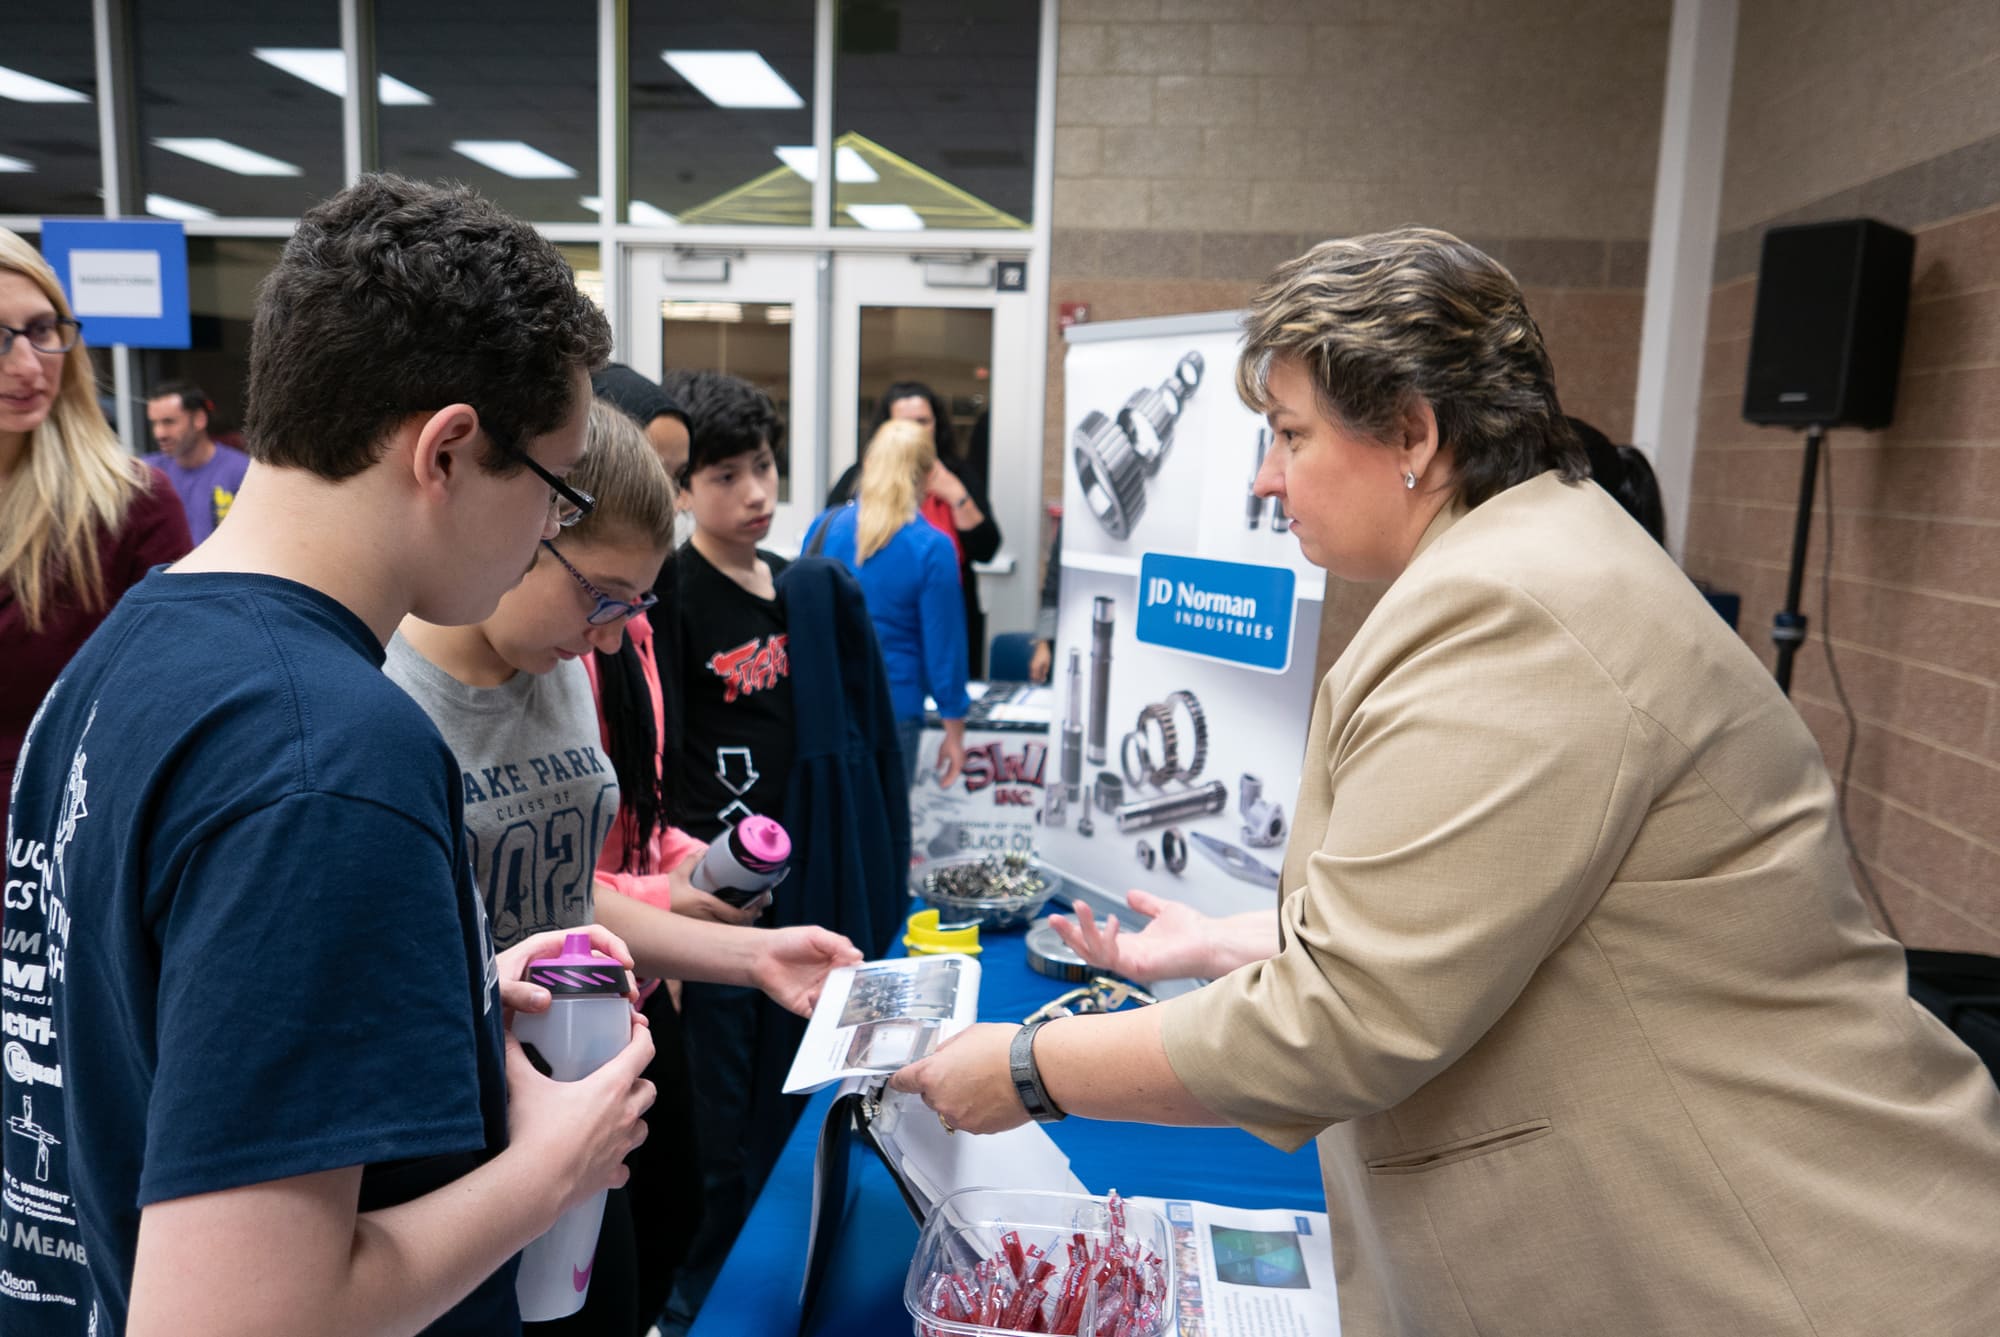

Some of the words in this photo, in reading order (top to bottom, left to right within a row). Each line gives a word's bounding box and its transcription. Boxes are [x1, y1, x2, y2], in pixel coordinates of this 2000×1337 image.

[1147, 576, 1174, 607] JD
[1176, 581, 1257, 619] Norman
[1174, 610, 1274, 641] INDUSTRIES
[463, 763, 529, 805] AKE
[528, 746, 606, 787] PARK
[496, 797, 546, 822] CLASS
[555, 790, 570, 806] OF
[4, 879, 38, 911] CS
[2, 927, 42, 955] UM
[2, 957, 47, 992] M
[12, 1221, 88, 1267] MEMB
